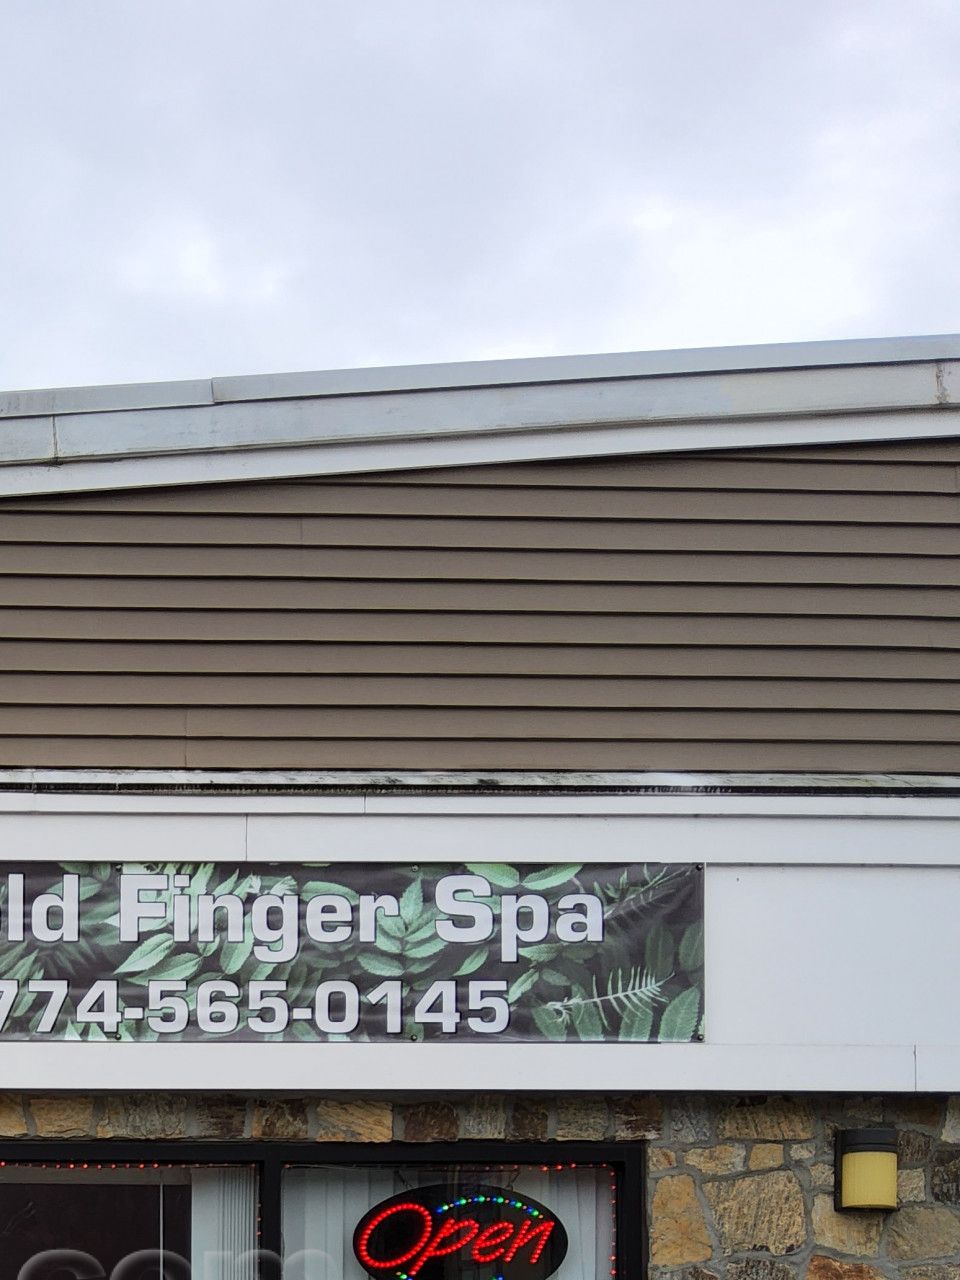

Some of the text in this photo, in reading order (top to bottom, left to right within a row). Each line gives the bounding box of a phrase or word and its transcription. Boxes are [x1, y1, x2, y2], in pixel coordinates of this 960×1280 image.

[119, 873, 400, 964] Finger
[434, 874, 605, 964] Spa
[358, 1202, 556, 1277] Open
